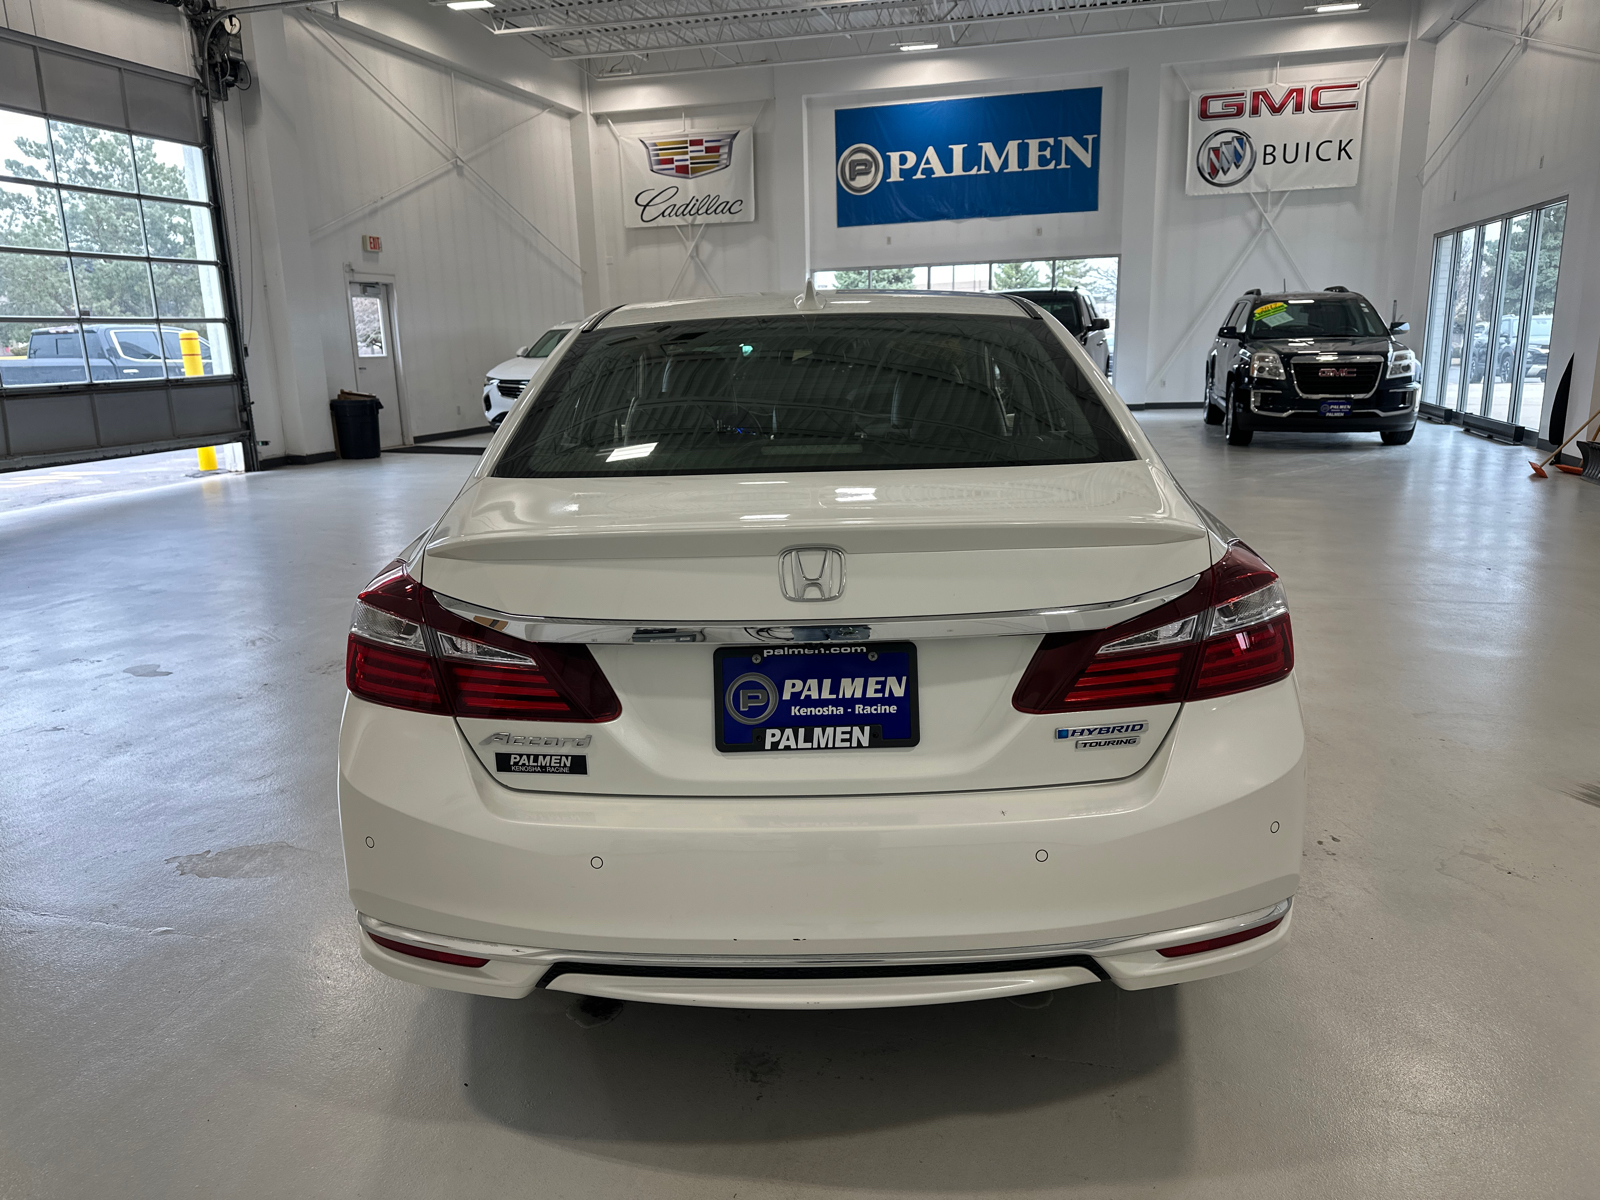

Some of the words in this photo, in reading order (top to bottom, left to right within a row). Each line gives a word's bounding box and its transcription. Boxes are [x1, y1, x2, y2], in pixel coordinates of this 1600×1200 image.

[1197, 81, 1361, 121] GMC
[886, 134, 1098, 182] PALMEN
[1262, 138, 1354, 166] BUICK
[634, 185, 744, 223] Cadillac
[1318, 368, 1357, 377] GMC
[782, 676, 907, 700] PALMEN
[791, 705, 844, 716] Kenosha
[855, 704, 897, 714] Racine
[479, 731, 593, 749] Accord
[764, 726, 870, 750] PALMEN
[1070, 723, 1144, 737] HYBRID
[1081, 738, 1137, 748] TOURING
[510, 754, 572, 767] PALMEN
